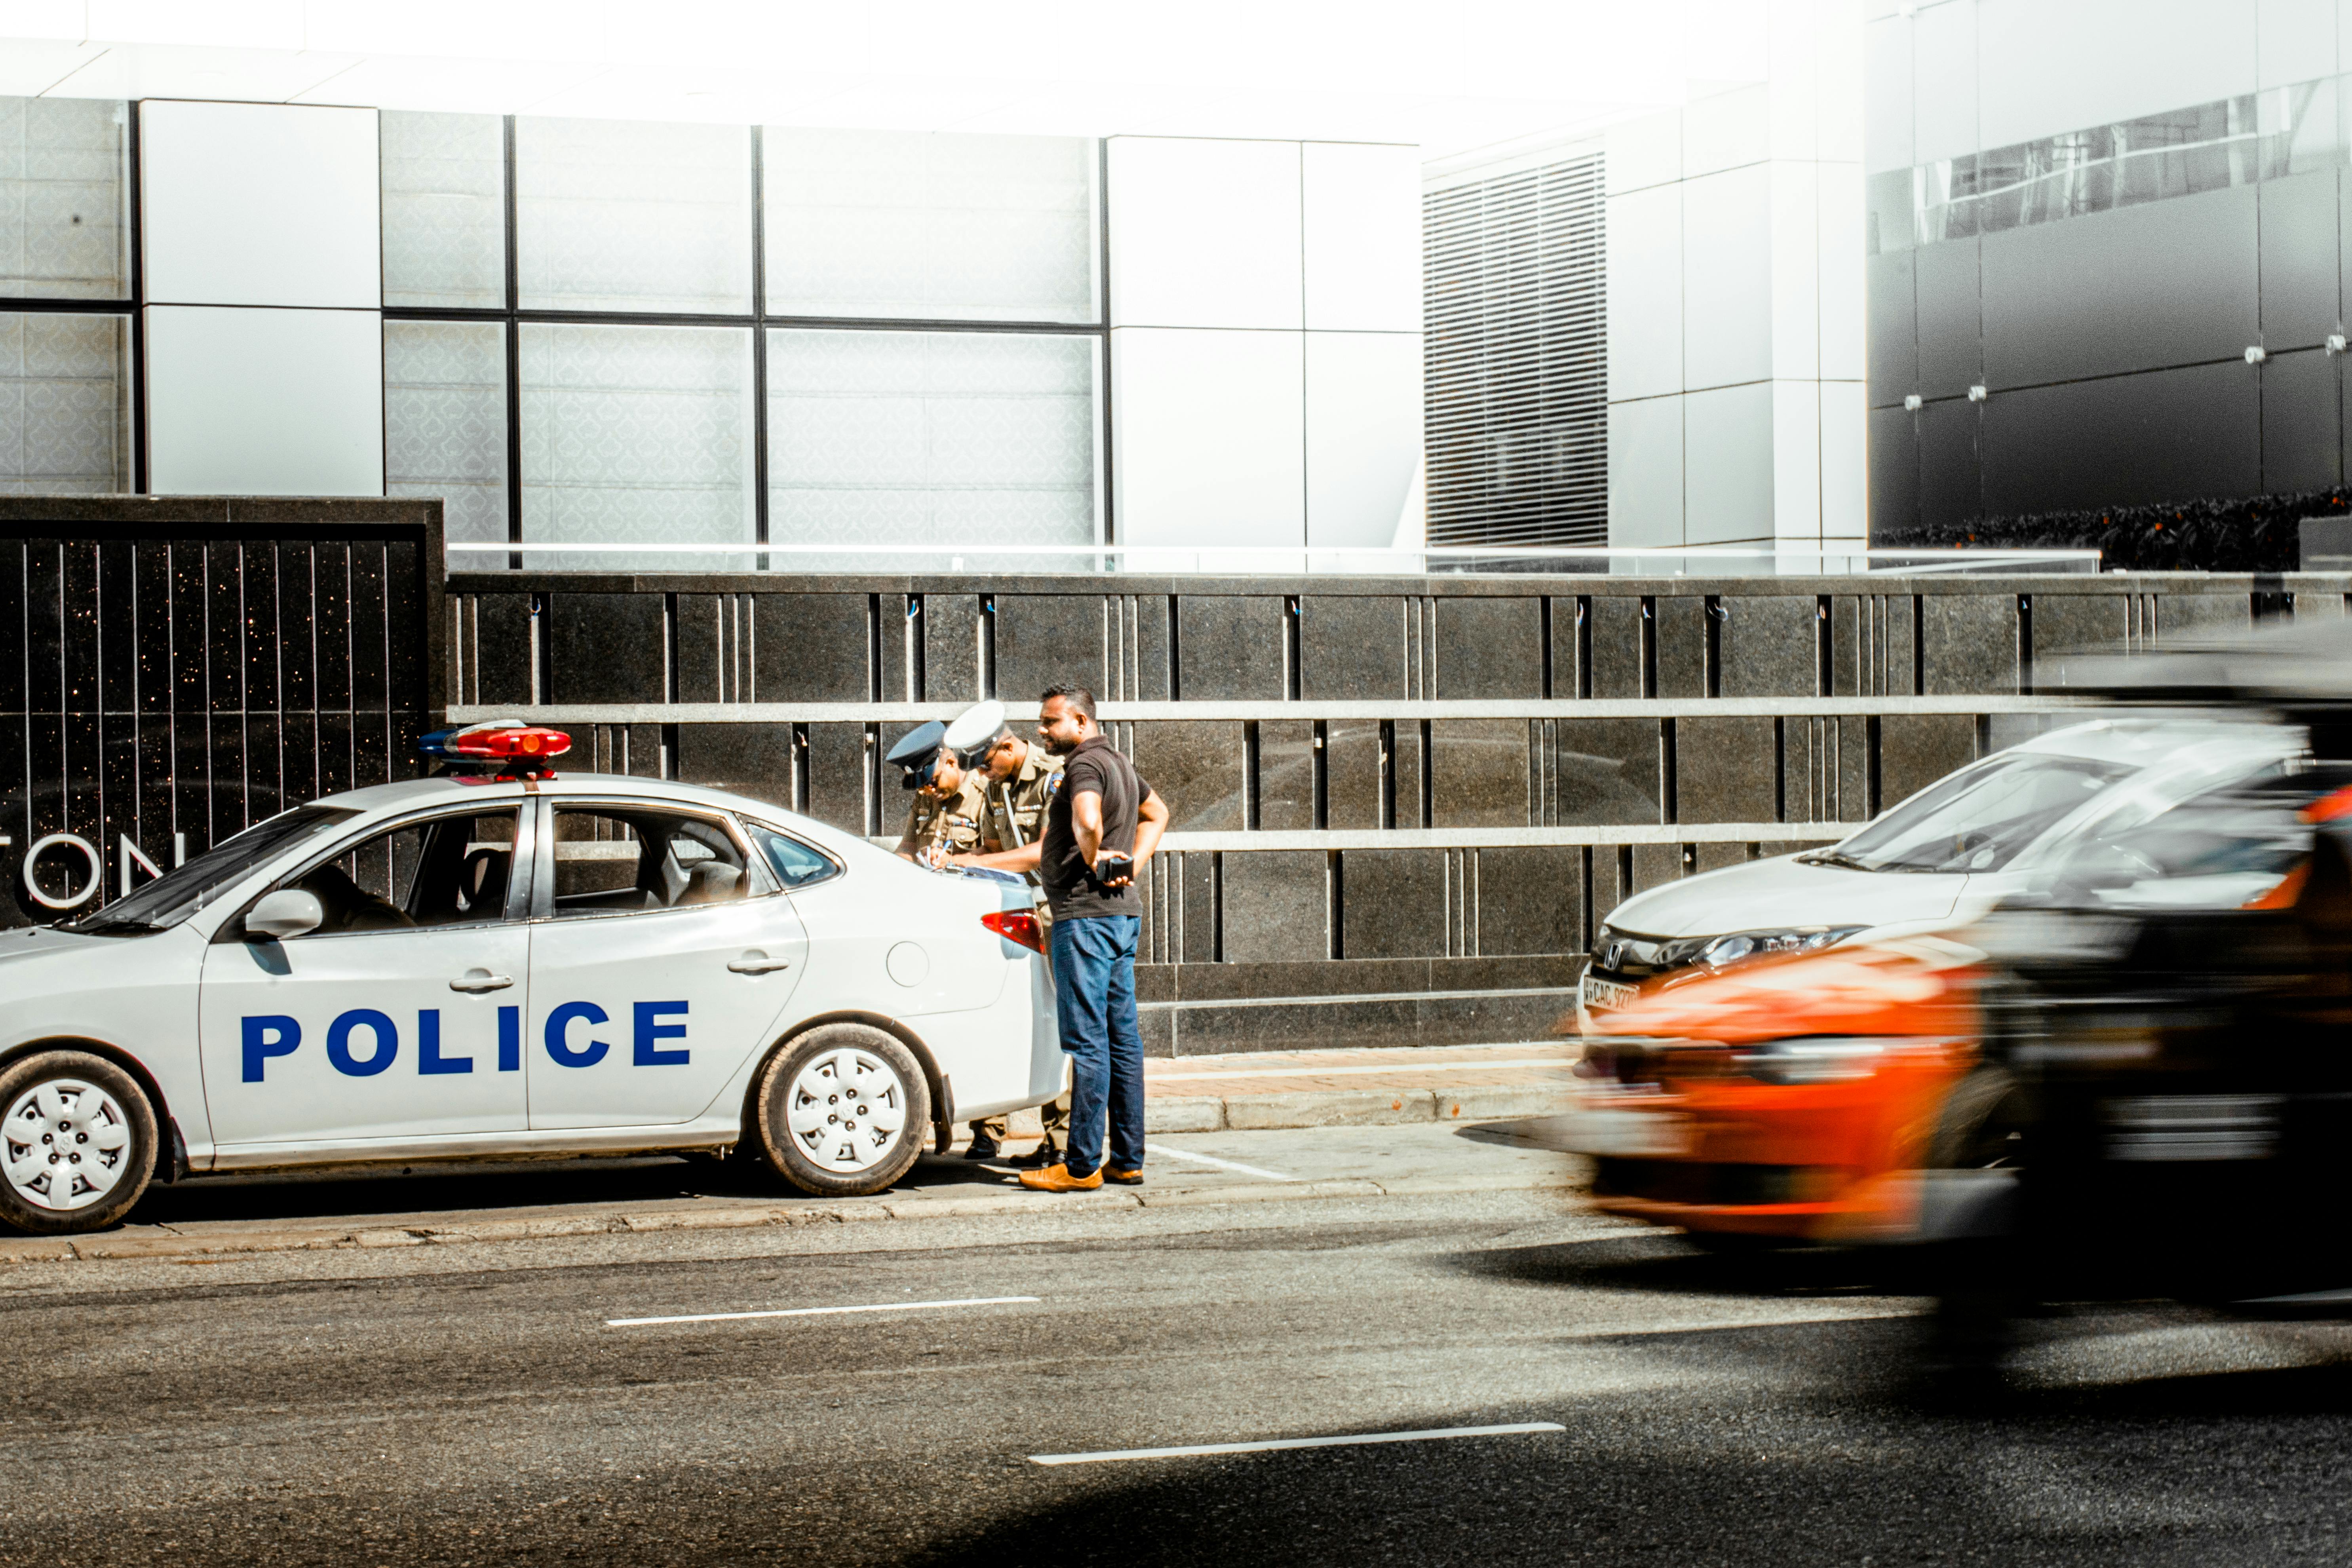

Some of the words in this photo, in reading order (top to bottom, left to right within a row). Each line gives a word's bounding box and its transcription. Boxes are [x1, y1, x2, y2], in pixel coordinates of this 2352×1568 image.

[0, 832, 185, 908] ON
[1593, 982, 1611, 1006] CAC
[241, 1000, 690, 1082] POLICE
